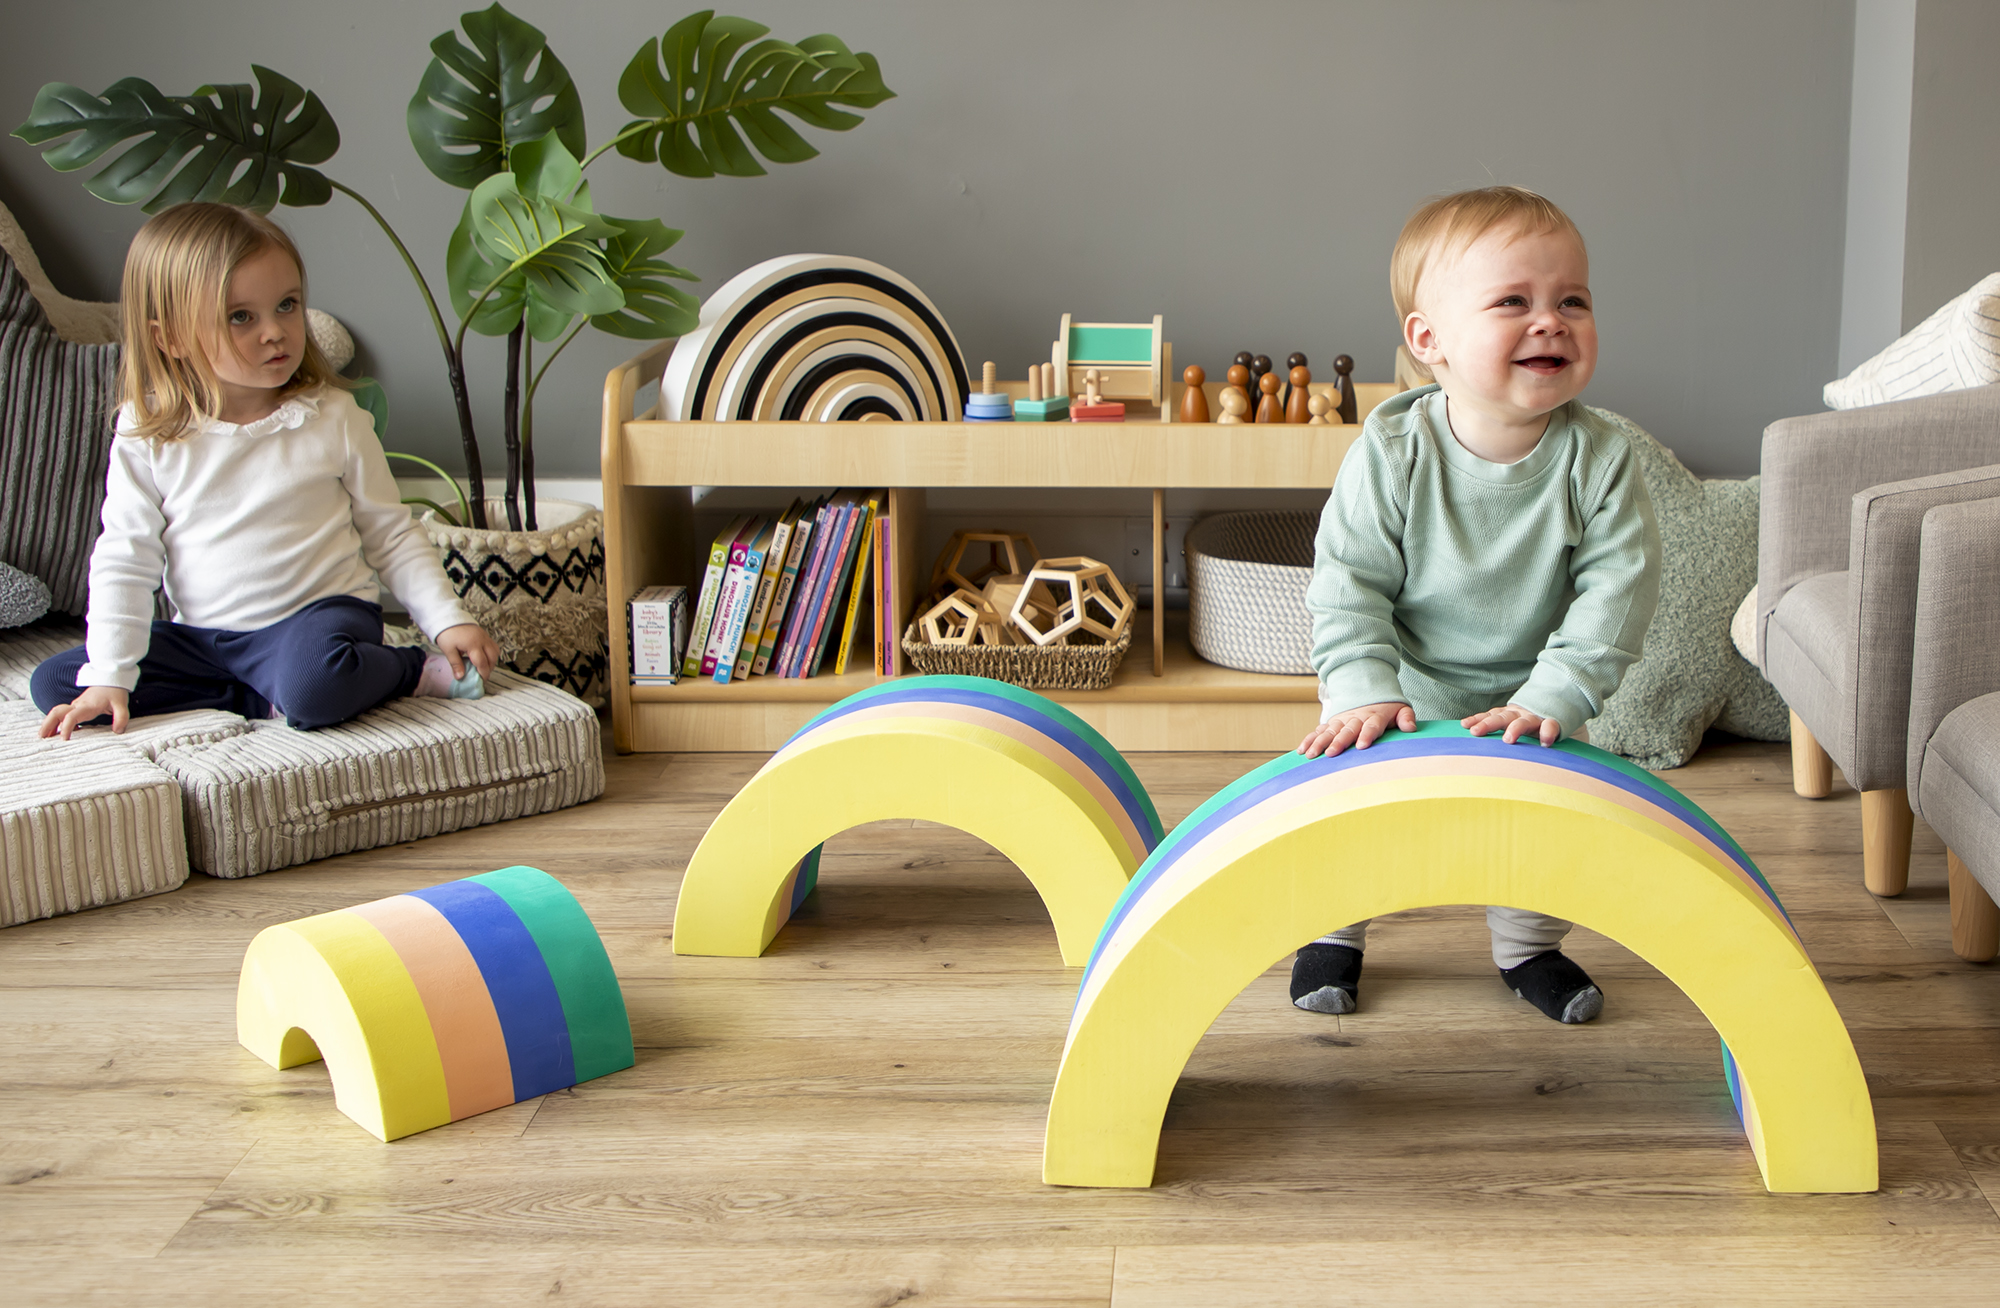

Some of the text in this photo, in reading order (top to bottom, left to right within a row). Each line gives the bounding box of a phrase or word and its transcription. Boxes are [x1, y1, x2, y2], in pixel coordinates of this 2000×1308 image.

[706, 578, 720, 616] DINOSAUR
[756, 578, 771, 614] Numbers
[776, 577, 790, 606] Colours
[716, 580, 738, 644] DINOSAUR HONK!
[728, 584, 752, 654] DINOSAUR MUNCH!
